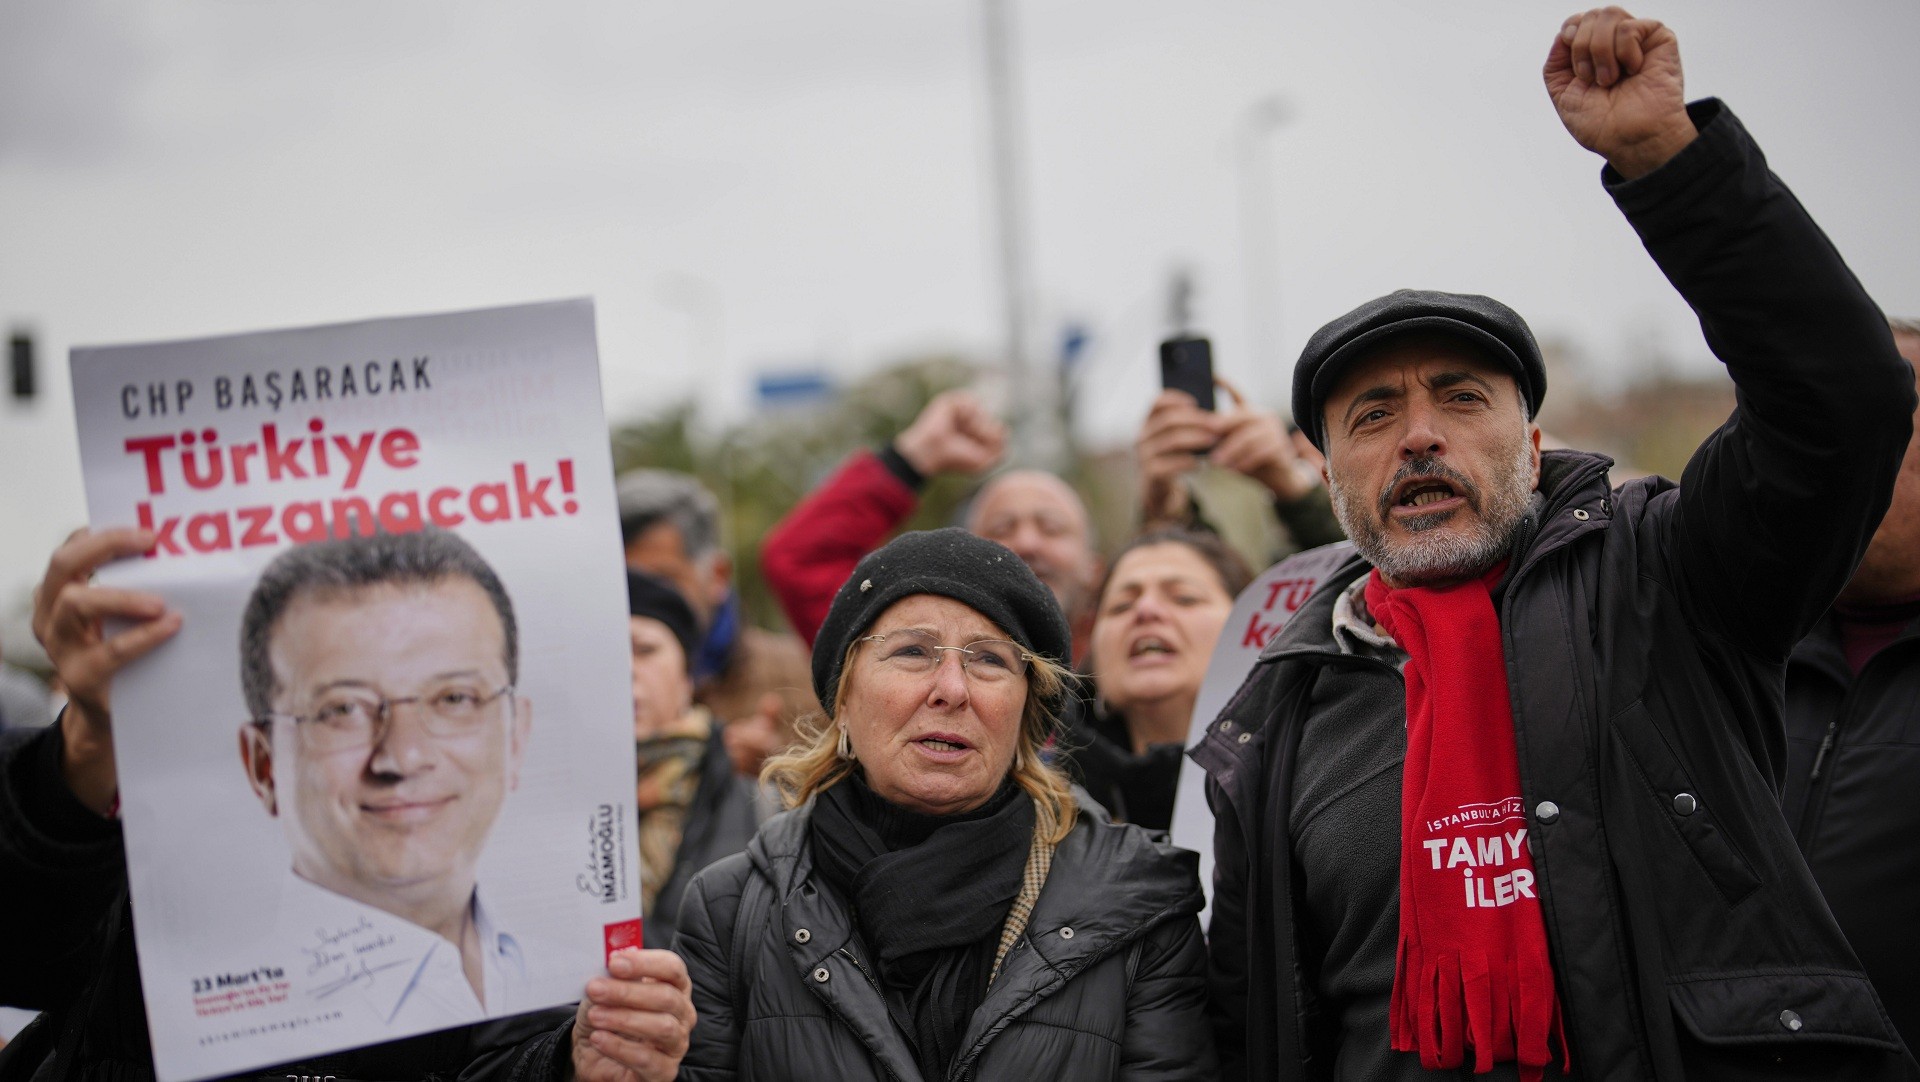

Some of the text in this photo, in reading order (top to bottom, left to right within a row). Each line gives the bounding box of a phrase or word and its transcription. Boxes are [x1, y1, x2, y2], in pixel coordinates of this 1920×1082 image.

[121, 381, 195, 420] CHP
[214, 356, 433, 412] BAŞARACAK
[124, 417, 421, 497] Türkiye
[136, 458, 580, 558] kazanacak!
[1426, 800, 1526, 832] İSTANBUL'A HİZ
[1422, 828, 1534, 870] TAMY
